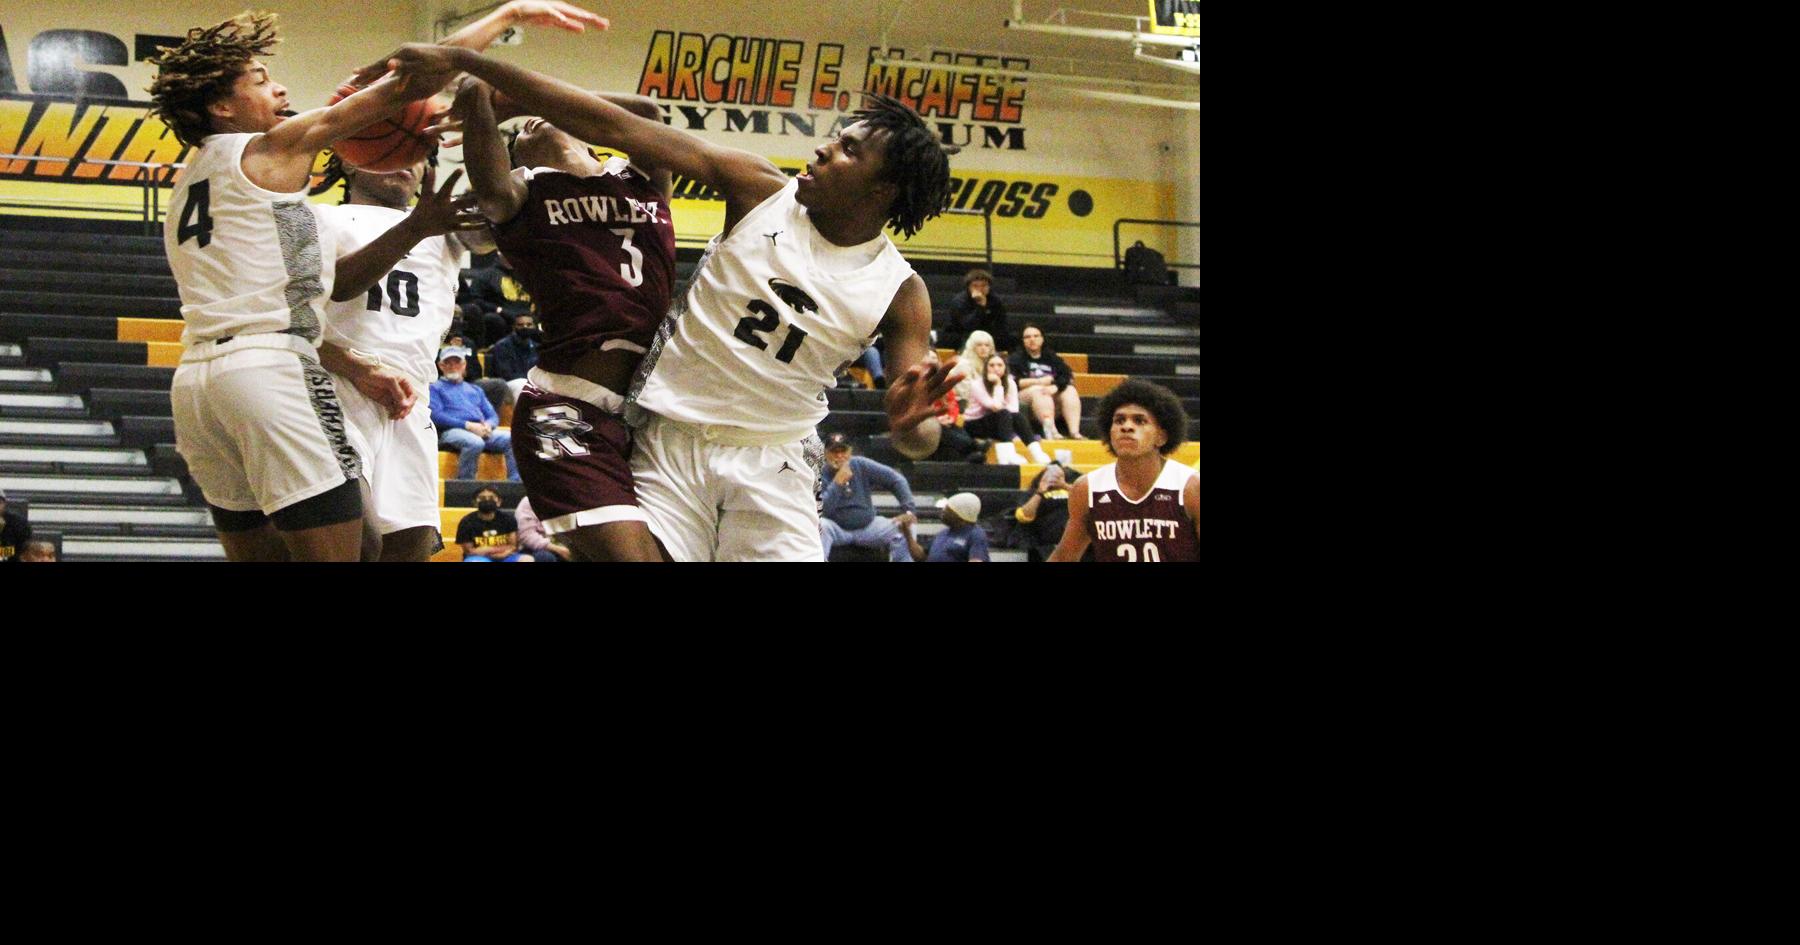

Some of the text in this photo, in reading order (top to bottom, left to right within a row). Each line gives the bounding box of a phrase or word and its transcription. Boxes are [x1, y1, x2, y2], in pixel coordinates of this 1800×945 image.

[636, 30, 804, 107] ARCHIE
[808, 42, 850, 112] E.
[178, 178, 214, 248] 4
[543, 196, 667, 226] ROWLET
[609, 227, 644, 288] 3
[734, 298, 808, 364] 21
[1094, 518, 1180, 540] ROWLETT
